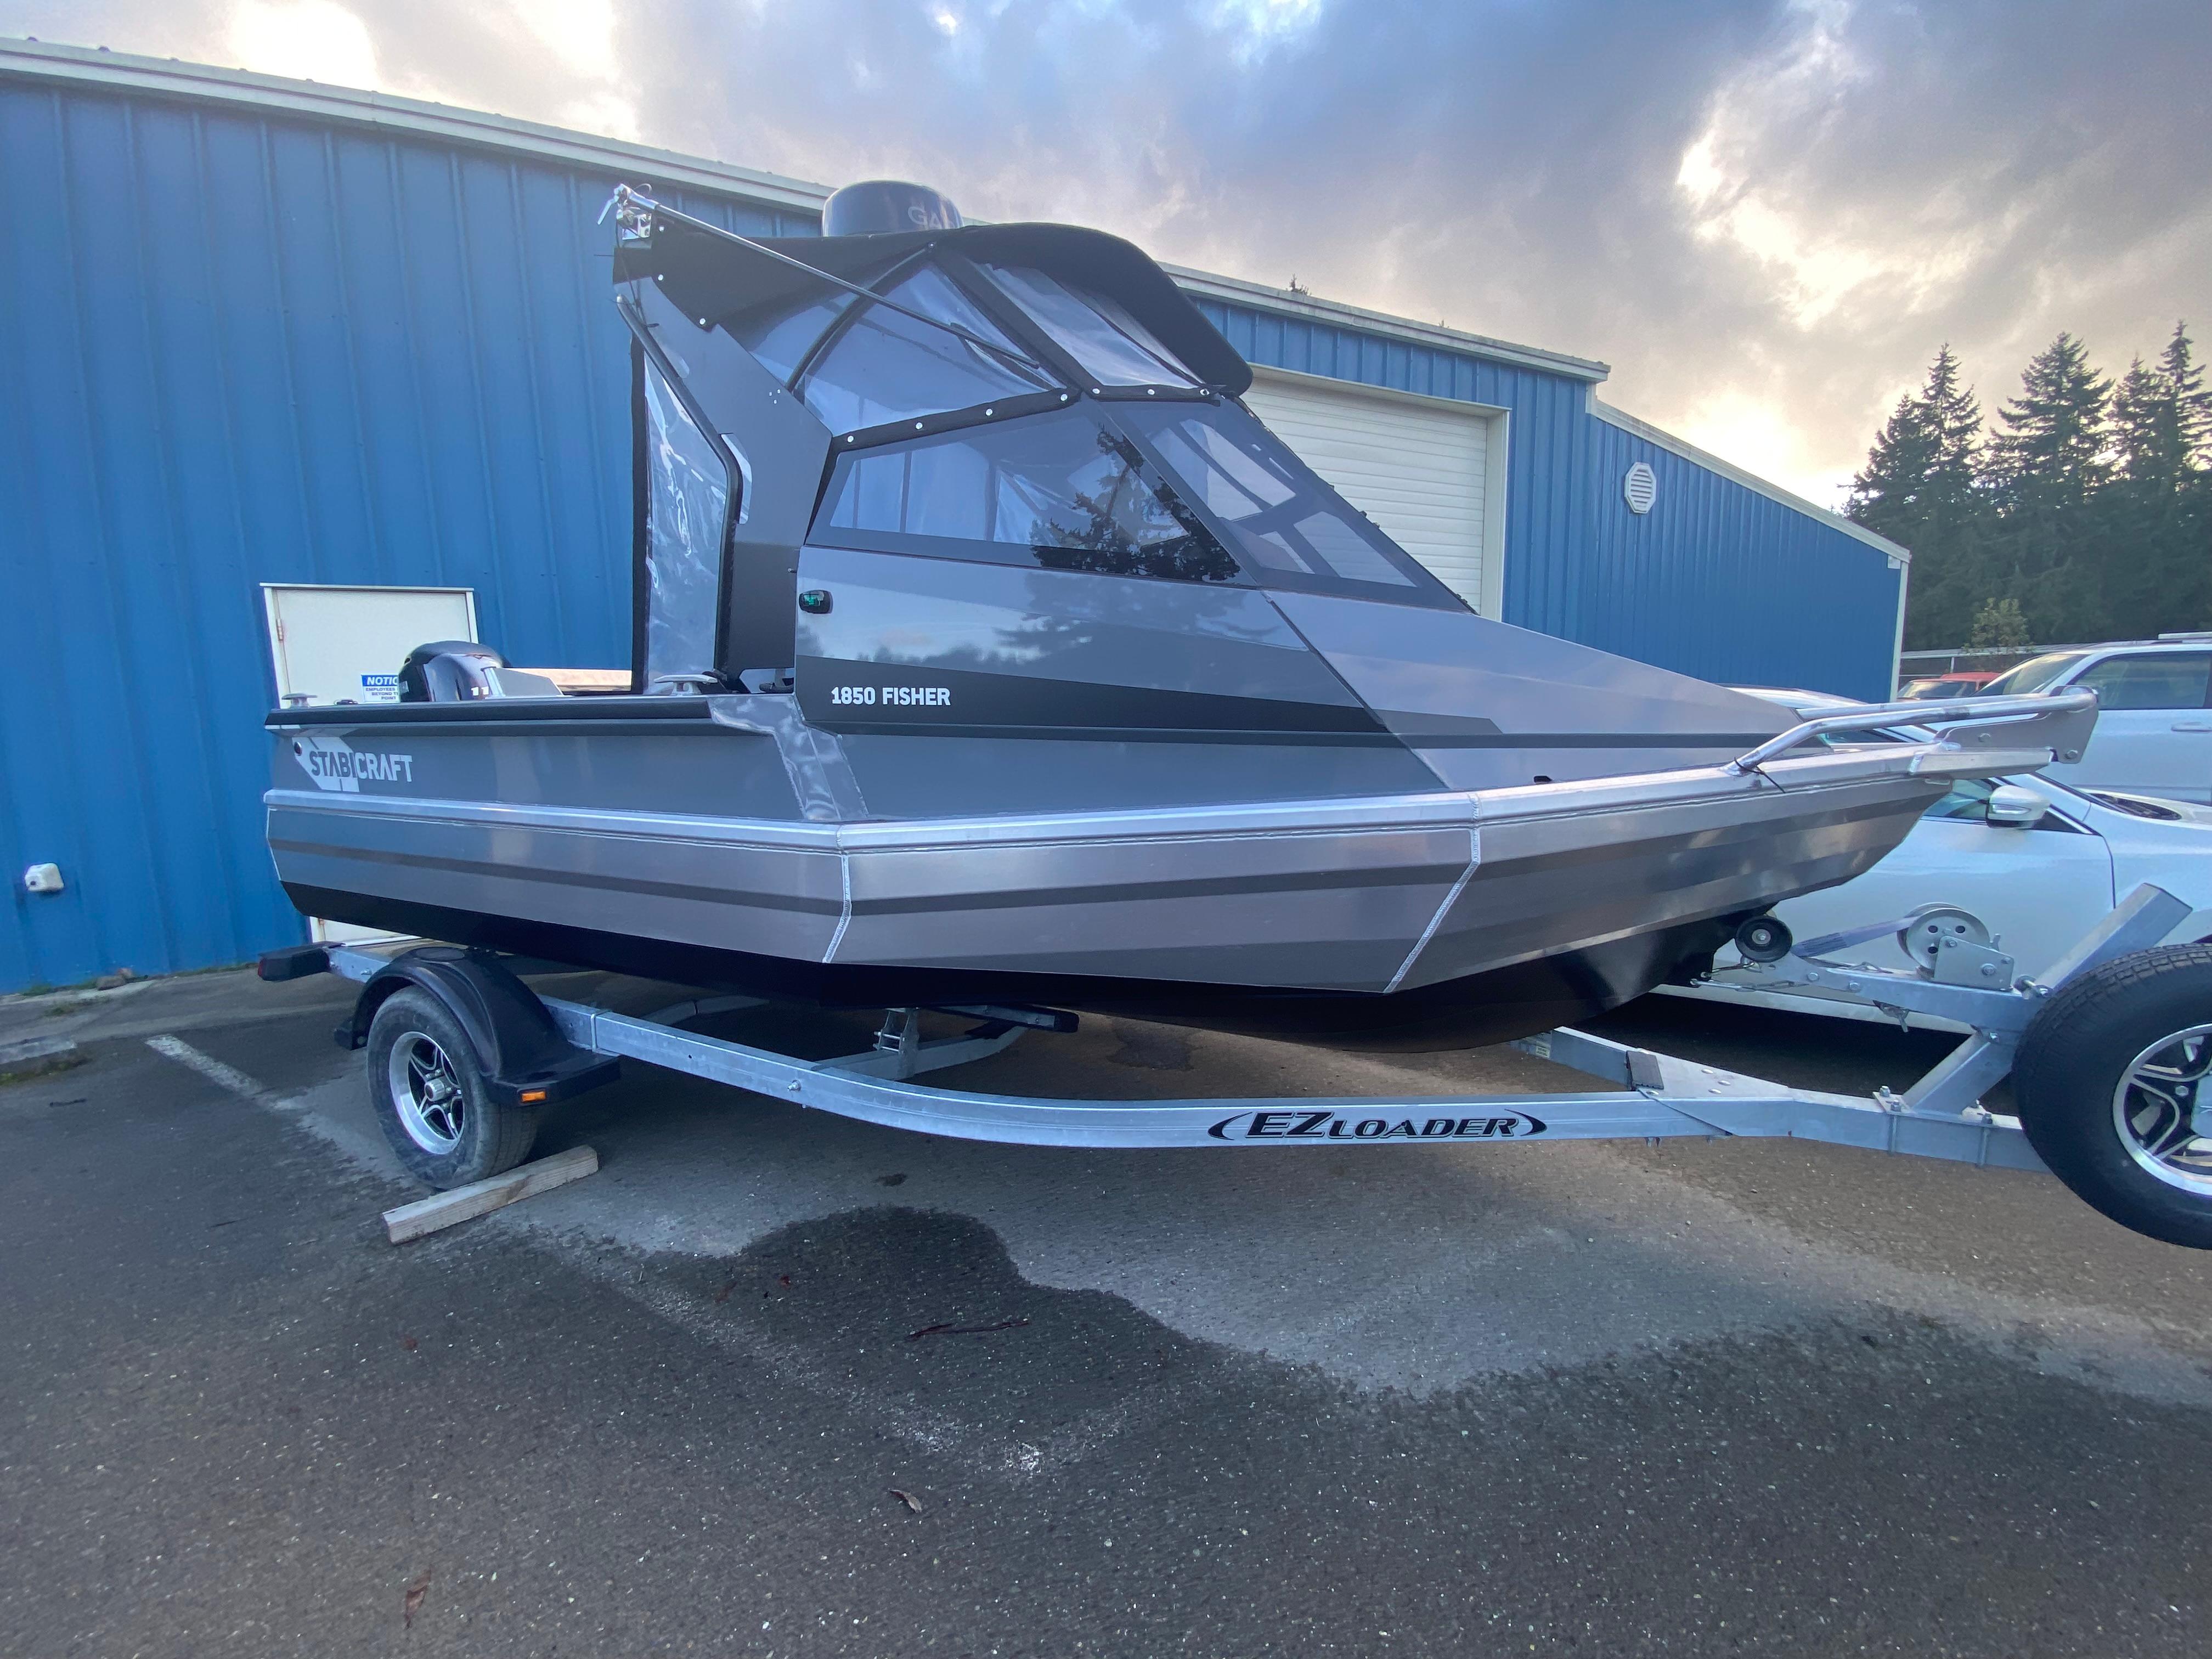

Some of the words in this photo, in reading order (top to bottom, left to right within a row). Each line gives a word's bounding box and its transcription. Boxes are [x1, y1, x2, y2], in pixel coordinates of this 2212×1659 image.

[831, 687, 876, 704] 1850
[882, 687, 951, 706] FISHER
[309, 751, 413, 782] STABICRAFT
